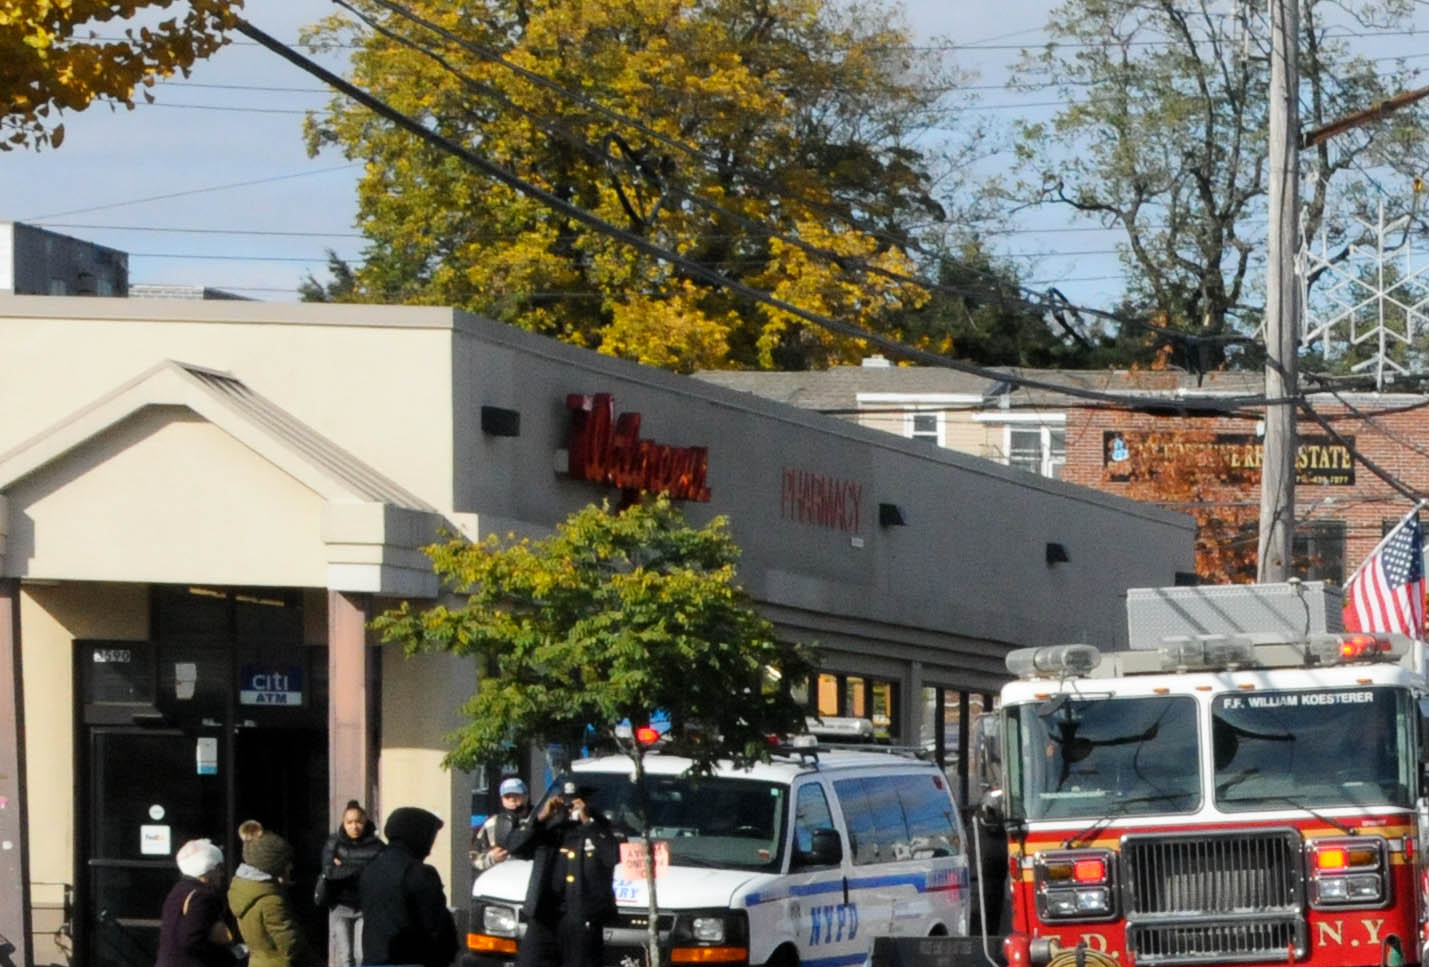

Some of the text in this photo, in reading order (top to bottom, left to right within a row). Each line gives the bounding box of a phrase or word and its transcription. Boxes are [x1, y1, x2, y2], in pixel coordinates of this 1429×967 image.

[782, 467, 862, 532] PHARMACY
[252, 671, 289, 690] citi
[256, 693, 288, 704] ATM
[1249, 695, 1298, 708] WILLIAM
[1302, 691, 1374, 704] KOESTERER
[809, 903, 858, 947] NYPD
